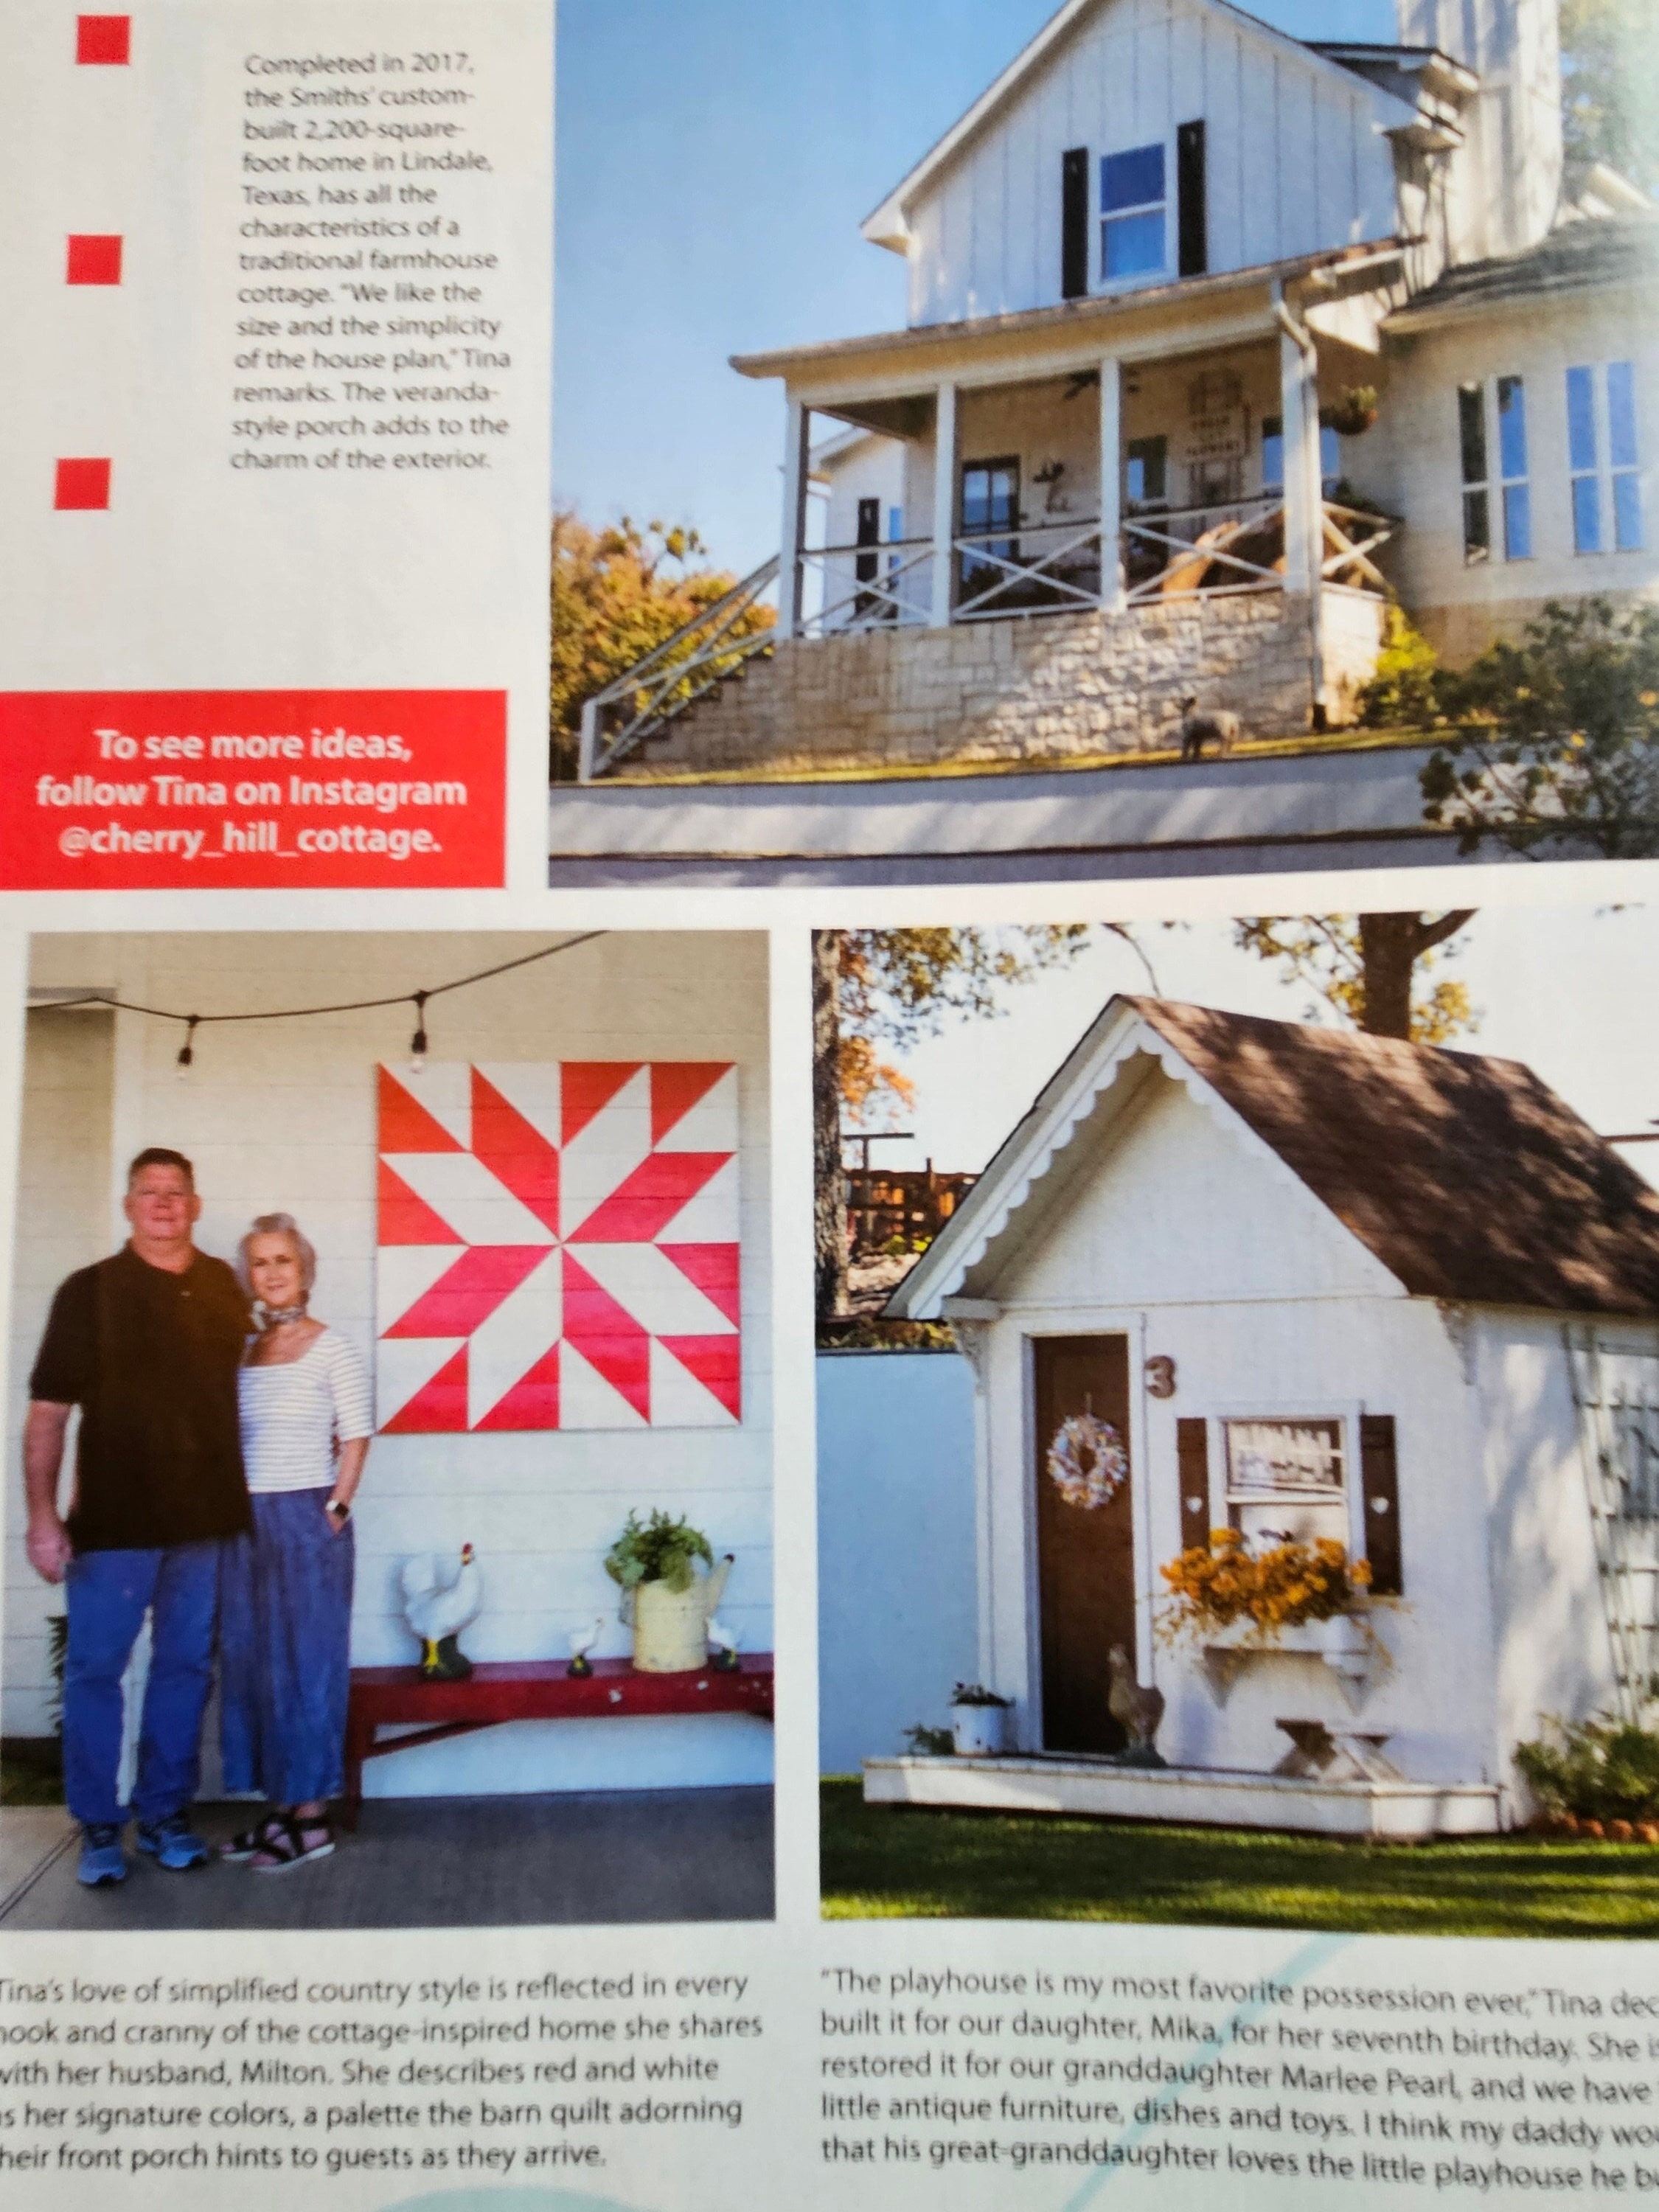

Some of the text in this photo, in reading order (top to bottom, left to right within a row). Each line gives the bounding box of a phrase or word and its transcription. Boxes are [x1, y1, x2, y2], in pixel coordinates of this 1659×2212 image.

[243, 52, 474, 79] Completed in 2017,
[243, 87, 284, 108] the
[378, 87, 475, 106] custom-
[241, 150, 493, 173] foot home in Lindale,
[240, 183, 438, 207] Texas, has all the
[239, 215, 460, 238] characteristics of a
[238, 248, 498, 271] traditional farmhouse
[237, 285, 335, 309] cottage.
[394, 282, 437, 303] like
[442, 282, 482, 303] the
[236, 315, 501, 341] size and the simplicity
[234, 347, 262, 369] of
[265, 349, 307, 370] the
[312, 348, 387, 369] house
[462, 347, 512, 369] Tina
[232, 381, 499, 403] remarks. The veranda-
[232, 414, 510, 441] style porch adds to the
[229, 448, 491, 470] charm of the exterior.
[93, 727, 413, 762] To see more ideas,
[35, 774, 467, 813] follow Tina on Instagram
[58, 820, 442, 860] @cherry_hill_cottage.
[1144, 1355, 1176, 1399] 3
[72, 1978, 128, 2004] love
[133, 1976, 163, 2004] of
[168, 1976, 299, 2009] simplified
[306, 1980, 412, 2008] country
[418, 1974, 481, 2008] style
[488, 1976, 508, 2001] is
[515, 1971, 634, 2000] reflected
[643, 1972, 667, 1997] in
[675, 1975, 748, 2002] every
[890, 1966, 1027, 2000] playhouse
[1035, 1969, 1054, 1995] is
[1063, 1975, 1104, 2003] my
[1112, 1976, 1180, 2001] most
[1188, 1972, 1294, 2006] favorite
[1302, 1985, 1456, 2013] possession
[1540, 1988, 1604, 2018] Tina
[65, 2017, 116, 2045] and
[123, 2025, 215, 2051] cranny
[220, 2017, 251, 2045] of
[256, 2017, 301, 2045] the
[307, 2014, 530, 2051] cottage-inspired
[538, 2014, 617, 2042] home
[624, 2013, 671, 2040] she
[678, 2011, 763, 2039] shares
[821, 2008, 881, 2037] built
[889, 2009, 906, 2036] it
[914, 2006, 950, 2036] for
[958, 2014, 1004, 2036] our
[1012, 2011, 1142, 2045] daughter,
[1150, 2014, 1225, 2045] Mika,
[1229, 2014, 1270, 2045] for
[1277, 2020, 1324, 2050] her
[1331, 2026, 1444, 2055] seventh
[1452, 2027, 1579, 2065] birthday.
[1587, 2031, 1641, 2062] She
[55, 2059, 101, 2087] her
[108, 2059, 232, 2088] husband,
[240, 2059, 334, 2086] Milton.
[341, 2058, 391, 2087] She
[397, 2057, 526, 2086] describes
[533, 2054, 577, 2083] red
[584, 2054, 636, 2082] and
[643, 2053, 720, 2081] white
[821, 2048, 1653, 2105] restored it for our granddaughter Marlee Pearl, and we have
[24, 2101, 69, 2129] her
[74, 2101, 203, 2135] signature
[208, 2099, 296, 2131] colors,
[302, 2106, 318, 2127] a
[326, 2098, 421, 2133] palette
[427, 2098, 473, 2128] the
[479, 2098, 542, 2127] barn
[549, 2096, 612, 2131] quilt
[619, 2096, 742, 2129] adorning
[821, 2091, 881, 2121] little
[888, 2093, 992, 2126] antique
[999, 2091, 1125, 2126] furniture,
[1133, 2098, 1221, 2129] dishes
[1230, 2102, 1282, 2132] and
[1289, 2110, 1356, 2141] toys.
[1363, 2109, 1371, 2137] I
[1377, 2109, 1454, 2142] think
[1460, 2120, 1504, 2151] my
[1512, 2115, 1603, 2149] daddy
[57, 2140, 124, 2171] front
[130, 2141, 209, 2176] porch
[215, 2141, 284, 2169] hints
[290, 2145, 319, 2169] to
[324, 2146, 414, 2176] guests
[420, 2148, 449, 2170] as
[456, 2140, 516, 2175] they
[524, 2140, 607, 2168] arrive.
[821, 2133, 876, 2163] that
[883, 2133, 922, 2162] his
[928, 2137, 1220, 2173] great-granddaughter
[1228, 2143, 1300, 2176] loves
[1307, 2148, 1355, 2180] the
[1362, 2150, 1427, 2183] little
[1434, 2158, 1583, 2193] playhouse
[1590, 2160, 1628, 2192] he
